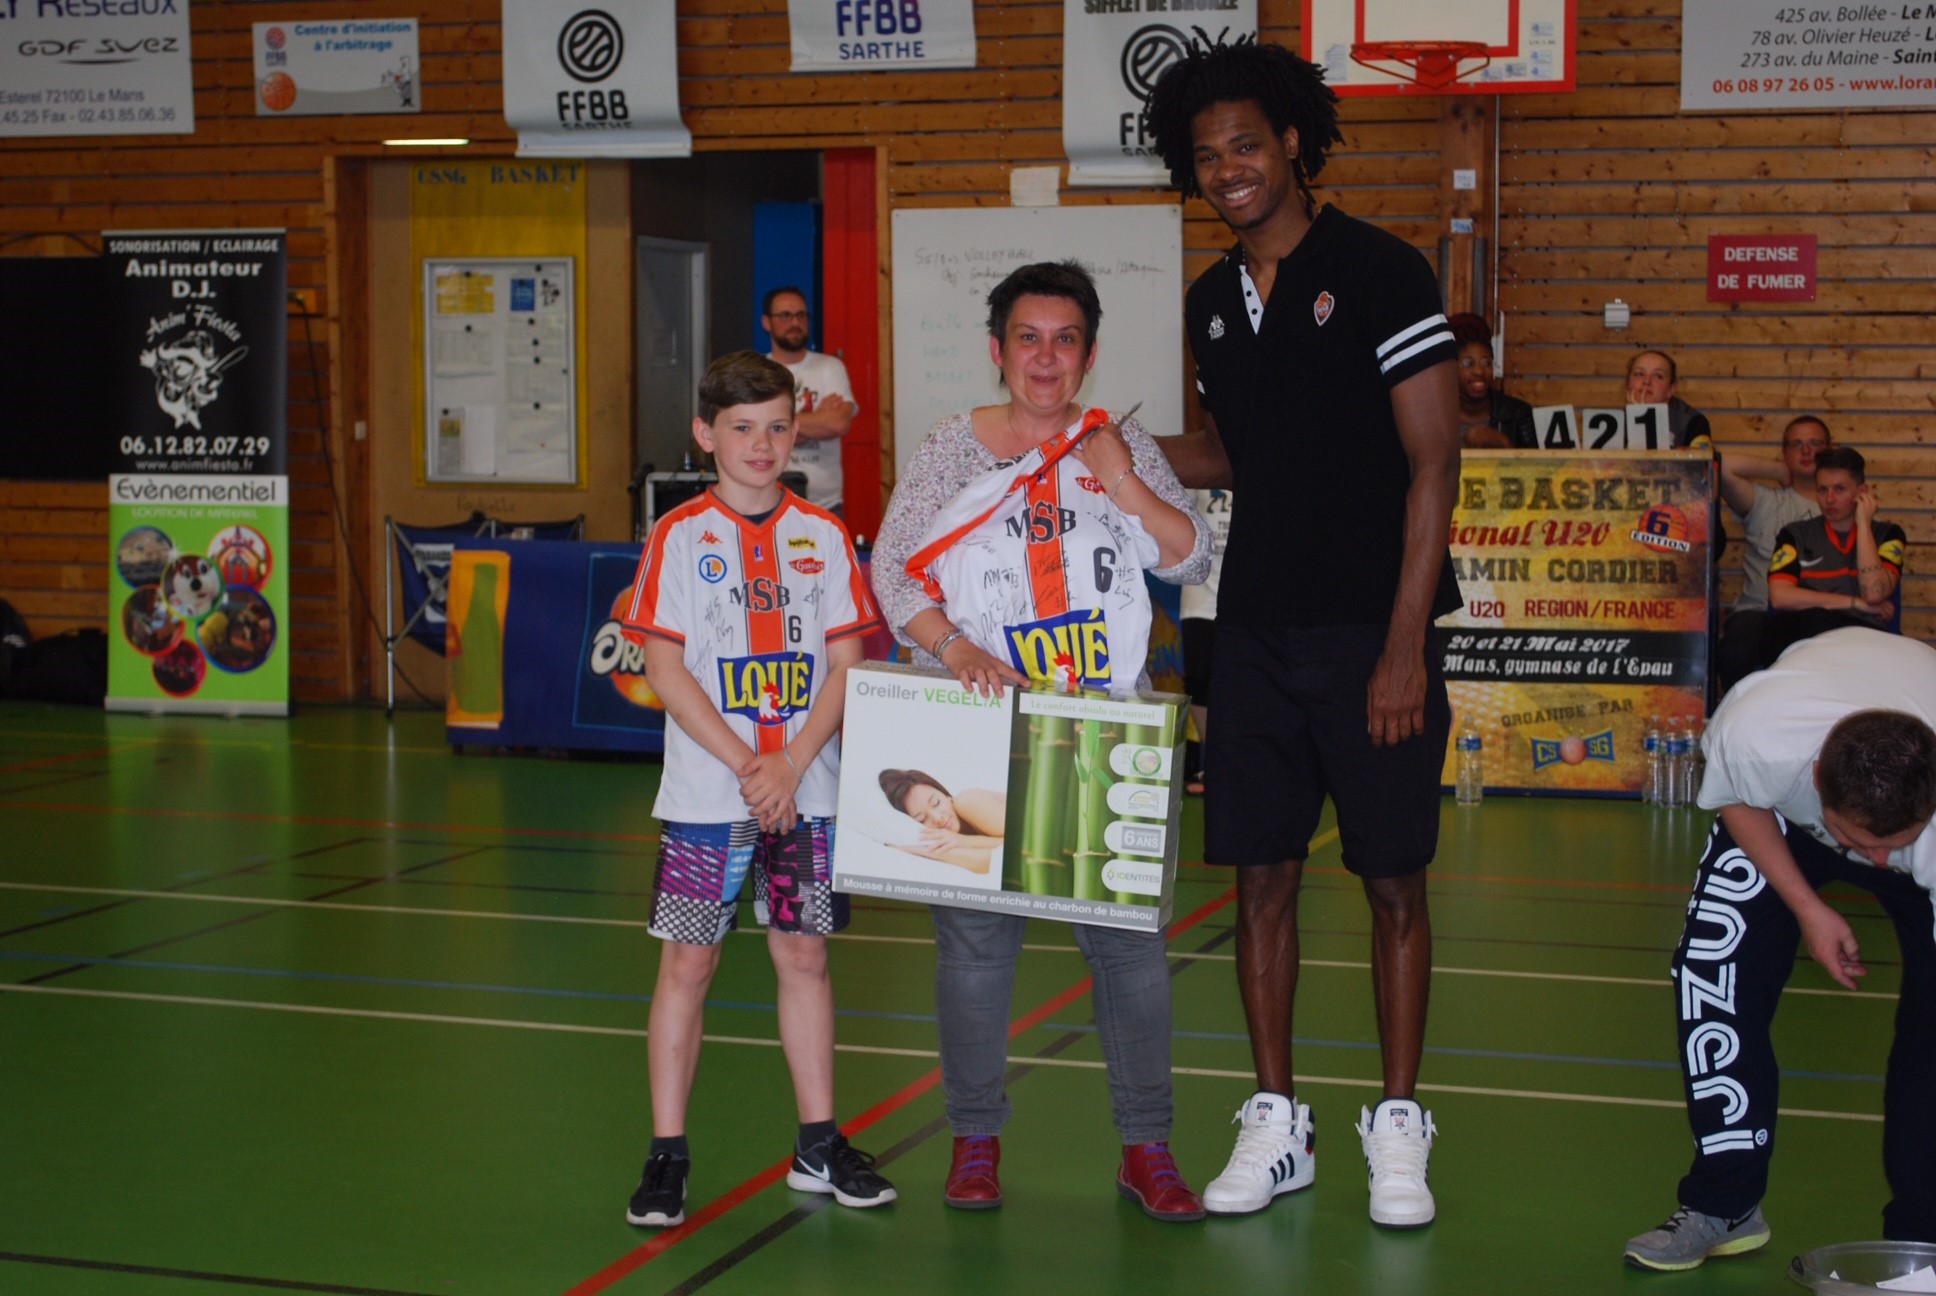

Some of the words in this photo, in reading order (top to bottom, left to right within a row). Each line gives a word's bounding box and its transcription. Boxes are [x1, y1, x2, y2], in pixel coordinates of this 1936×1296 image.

[836, 0, 922, 36] FFBB
[1775, 8, 1805, 23] 425
[1809, 10, 1832, 23] av.
[1837, 5, 1887, 22] Bollée
[1901, 5, 1922, 20] Le
[295, 24, 337, 36] Centre
[342, 22, 412, 34] d'initiation
[1751, 30, 1771, 46] 78
[1774, 32, 1797, 45] av.
[1802, 28, 1855, 45] Olivier
[1859, 26, 1910, 43] Heuzé
[18, 39, 87, 57] GDF
[326, 40, 393, 52] l'arbitrage
[839, 41, 925, 60] SARTHE
[1740, 53, 1770, 68] 273
[1774, 54, 1797, 67] av.
[1801, 50, 1823, 66] du
[1827, 49, 1879, 66] Maine
[1713, 80, 1734, 94] 06
[1737, 79, 1758, 93] 08
[1763, 79, 1784, 92] 97
[1789, 78, 1809, 92] 26
[1813, 77, 1834, 91] 05
[88, 89, 105, 103] Le
[108, 88, 145, 103] Mans
[557, 89, 629, 121] FFBB
[42, 109, 66, 123] Fax
[490, 163, 583, 184] BASKET
[109, 239, 199, 254] SONORISATION
[212, 238, 280, 253] ECLAIRAGE
[1724, 246, 1799, 262] DEFENSE
[125, 258, 263, 277] Animateur
[171, 279, 217, 298] D.J.
[1717, 274, 1740, 289] DE
[1747, 274, 1806, 289] FUMER
[120, 435, 270, 456] 06.12.82.07.29
[135, 457, 254, 472] www.animfiesta.fr
[1499, 477, 1681, 511] BASKET
[1006, 500, 1077, 543] MSB
[1647, 511, 1671, 537] 6
[1449, 520, 1538, 548] ional
[1540, 520, 1611, 547] U20
[1093, 546, 1116, 593] 6
[1454, 557, 1531, 582] AMIN
[1547, 558, 1679, 584] CORDIER
[729, 577, 791, 612] MSB
[1470, 601, 1505, 619] U20
[788, 615, 803, 643] 6
[1447, 635, 1475, 649] 20
[1476, 636, 1498, 650] et
[1499, 636, 1523, 651] 21
[1523, 635, 1577, 652] Mai
[1579, 637, 1631, 653] 2017
[1504, 657, 1582, 676] gymnase
[1586, 657, 1607, 675] de
[856, 681, 918, 701] Oreiller
[1043, 701, 1077, 713] confort
[1079, 704, 1107, 716] absolu
[1110, 708, 1121, 717] au
[1123, 710, 1155, 720] naturel
[1598, 698, 1634, 715] PAR
[1124, 830, 1135, 846] 6
[1136, 836, 1159, 849] ANS
[843, 878, 883, 892] Mousse
[885, 882, 892, 892] à
[894, 884, 939, 898] mémoire
[941, 889, 954, 899] de
[957, 891, 987, 903] forme
[989, 894, 1031, 909] enrichie
[1033, 900, 1046, 910] au
[1048, 900, 1092, 915] charbon
[1094, 905, 1107, 916] de
[1109, 907, 1153, 921] bambou
